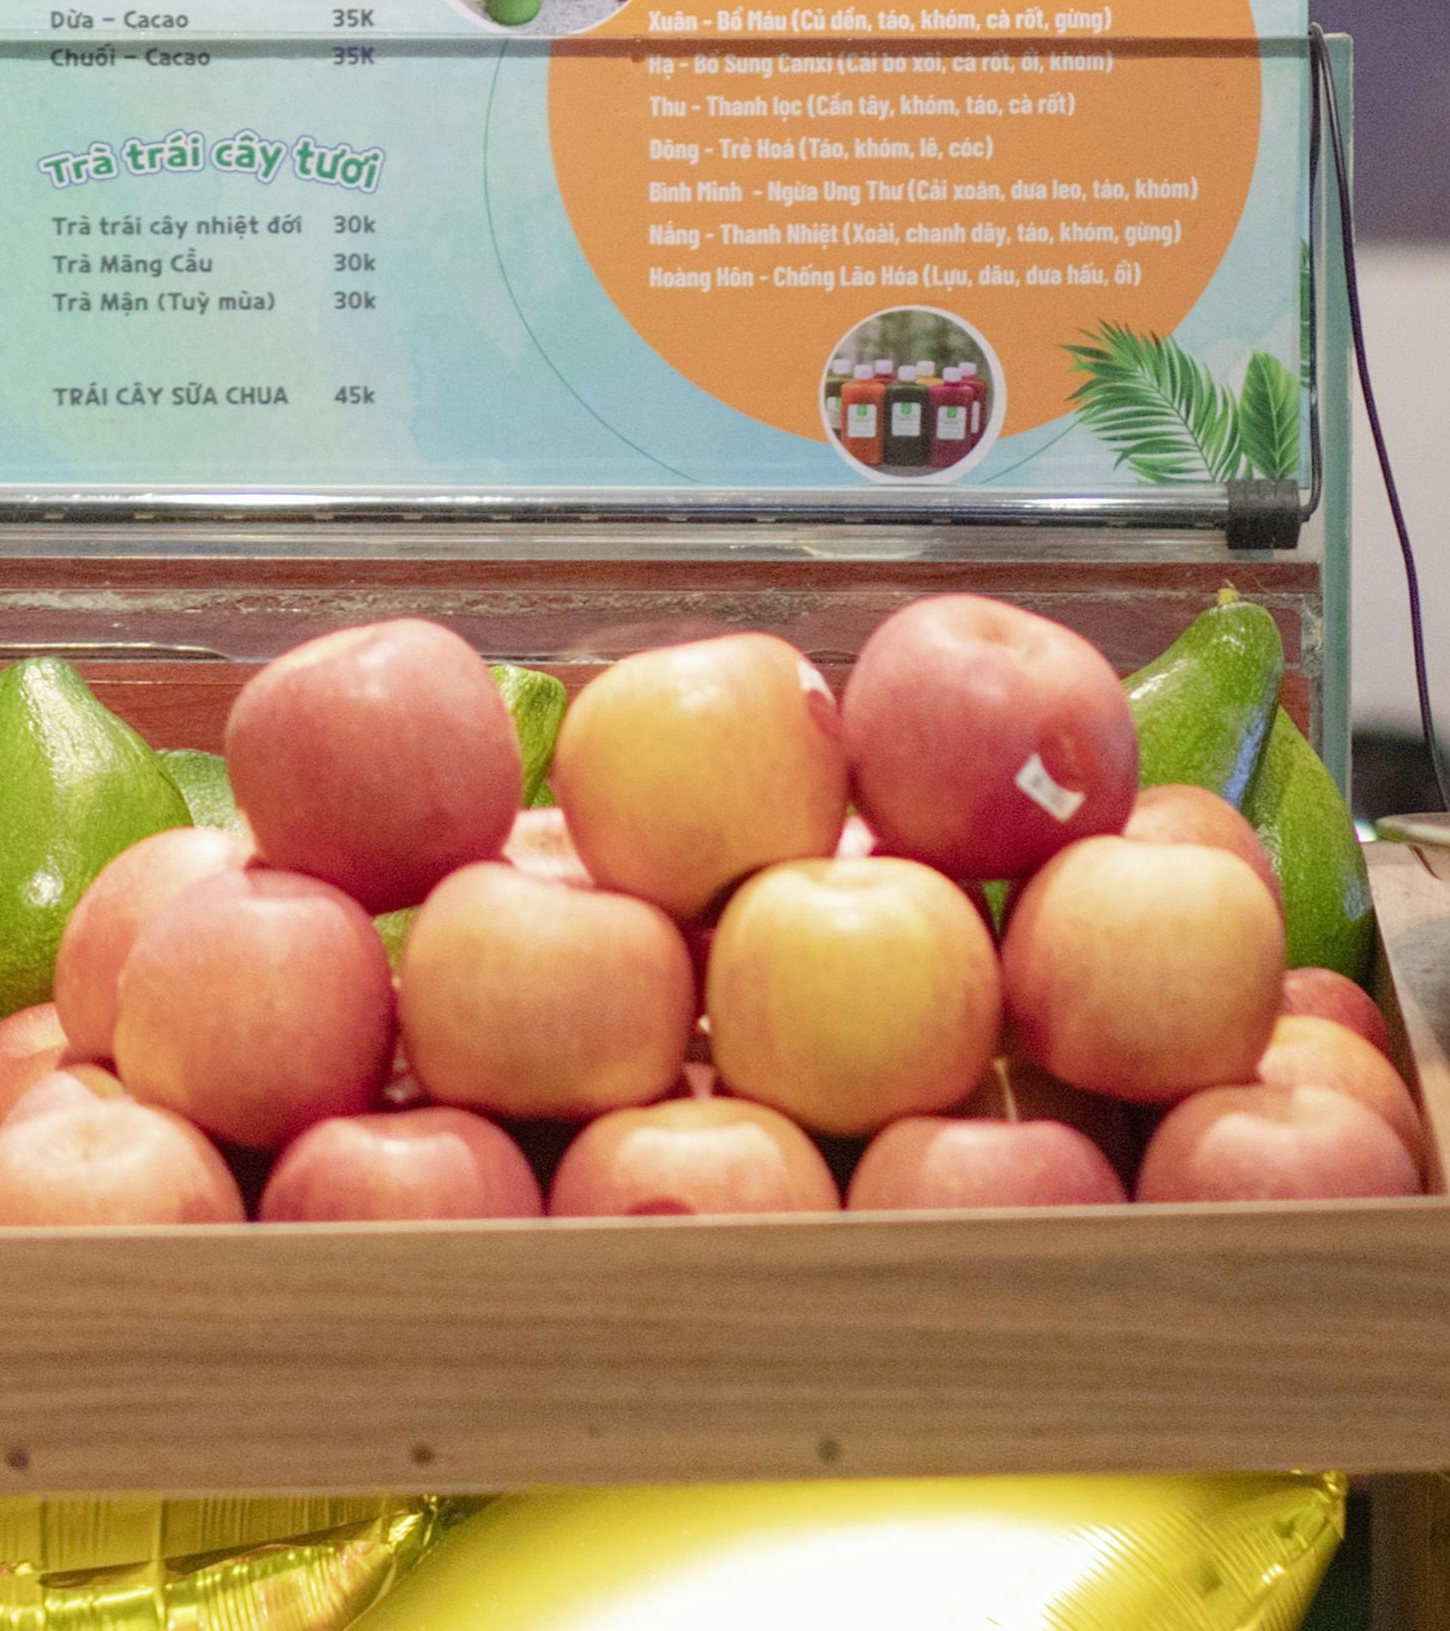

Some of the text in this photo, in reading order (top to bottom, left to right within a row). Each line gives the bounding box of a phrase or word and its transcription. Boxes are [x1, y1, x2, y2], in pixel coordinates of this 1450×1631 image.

[44, 135, 380, 188] Trà trái cây tươi
[52, 214, 375, 239] Trà trái cây nhiệt đới 30k
[52, 290, 375, 316] Trà Mận (Tuỳ mùa) 30k
[53, 382, 375, 406] TRÁI CÂY SỮA CHUA 45k
